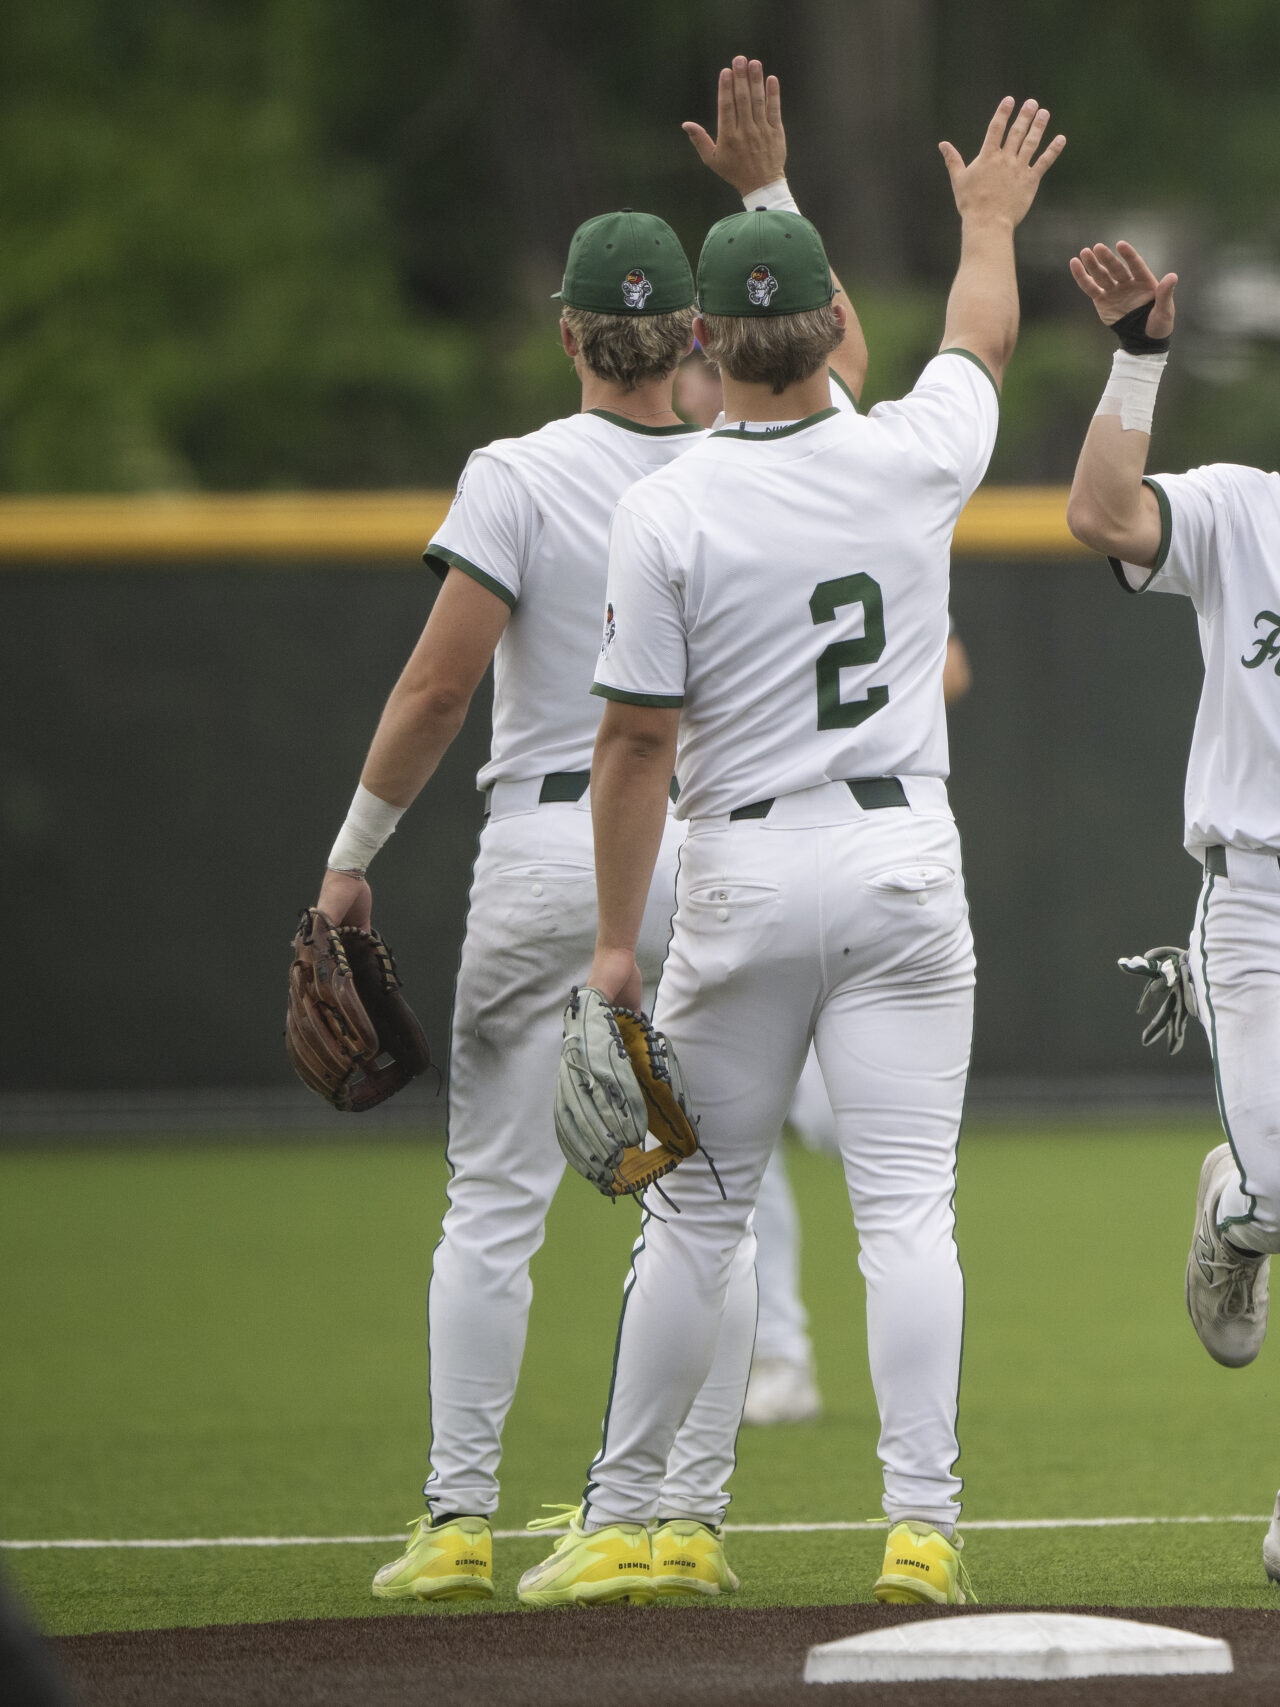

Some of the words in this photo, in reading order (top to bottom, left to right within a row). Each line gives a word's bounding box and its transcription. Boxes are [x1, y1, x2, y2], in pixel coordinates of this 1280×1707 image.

[808, 571, 890, 732] 2
[663, 1559, 696, 1568] DIAMOND
[895, 1558, 930, 1571] DIAMOND
